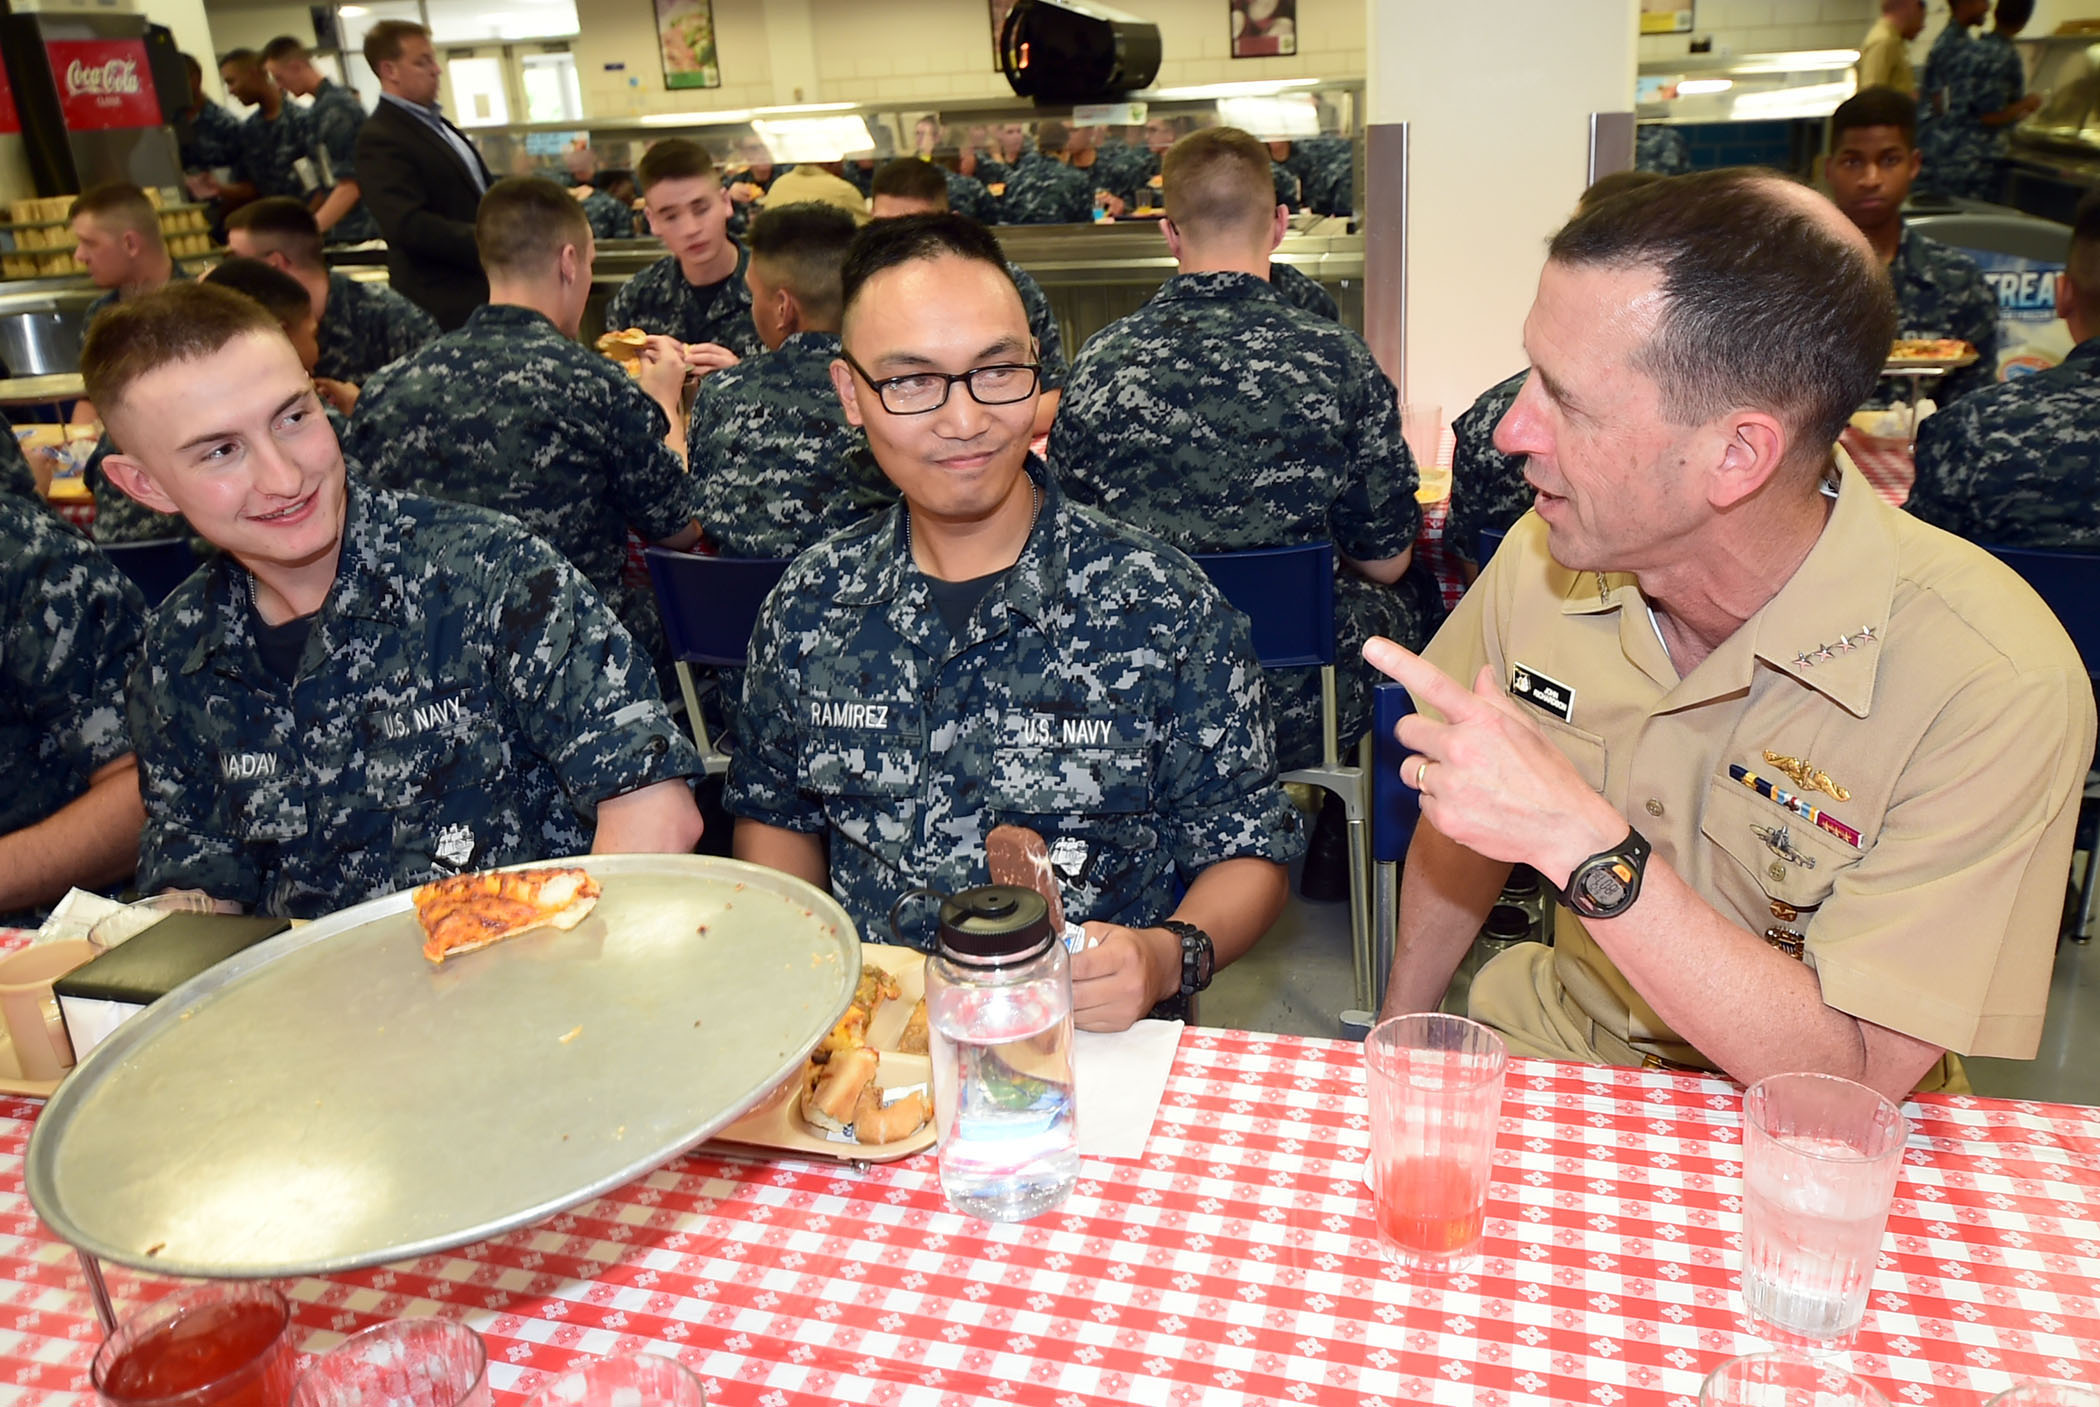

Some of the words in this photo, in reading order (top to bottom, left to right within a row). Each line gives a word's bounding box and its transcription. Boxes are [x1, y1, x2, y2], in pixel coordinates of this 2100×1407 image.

[67, 58, 139, 96] Coca-Cola
[384, 711, 410, 740] U.S.
[413, 695, 460, 732] NAVY
[811, 701, 889, 729] RAMIREZ
[1025, 718, 1053, 743] U.S.
[1063, 719, 1112, 744] NAVY
